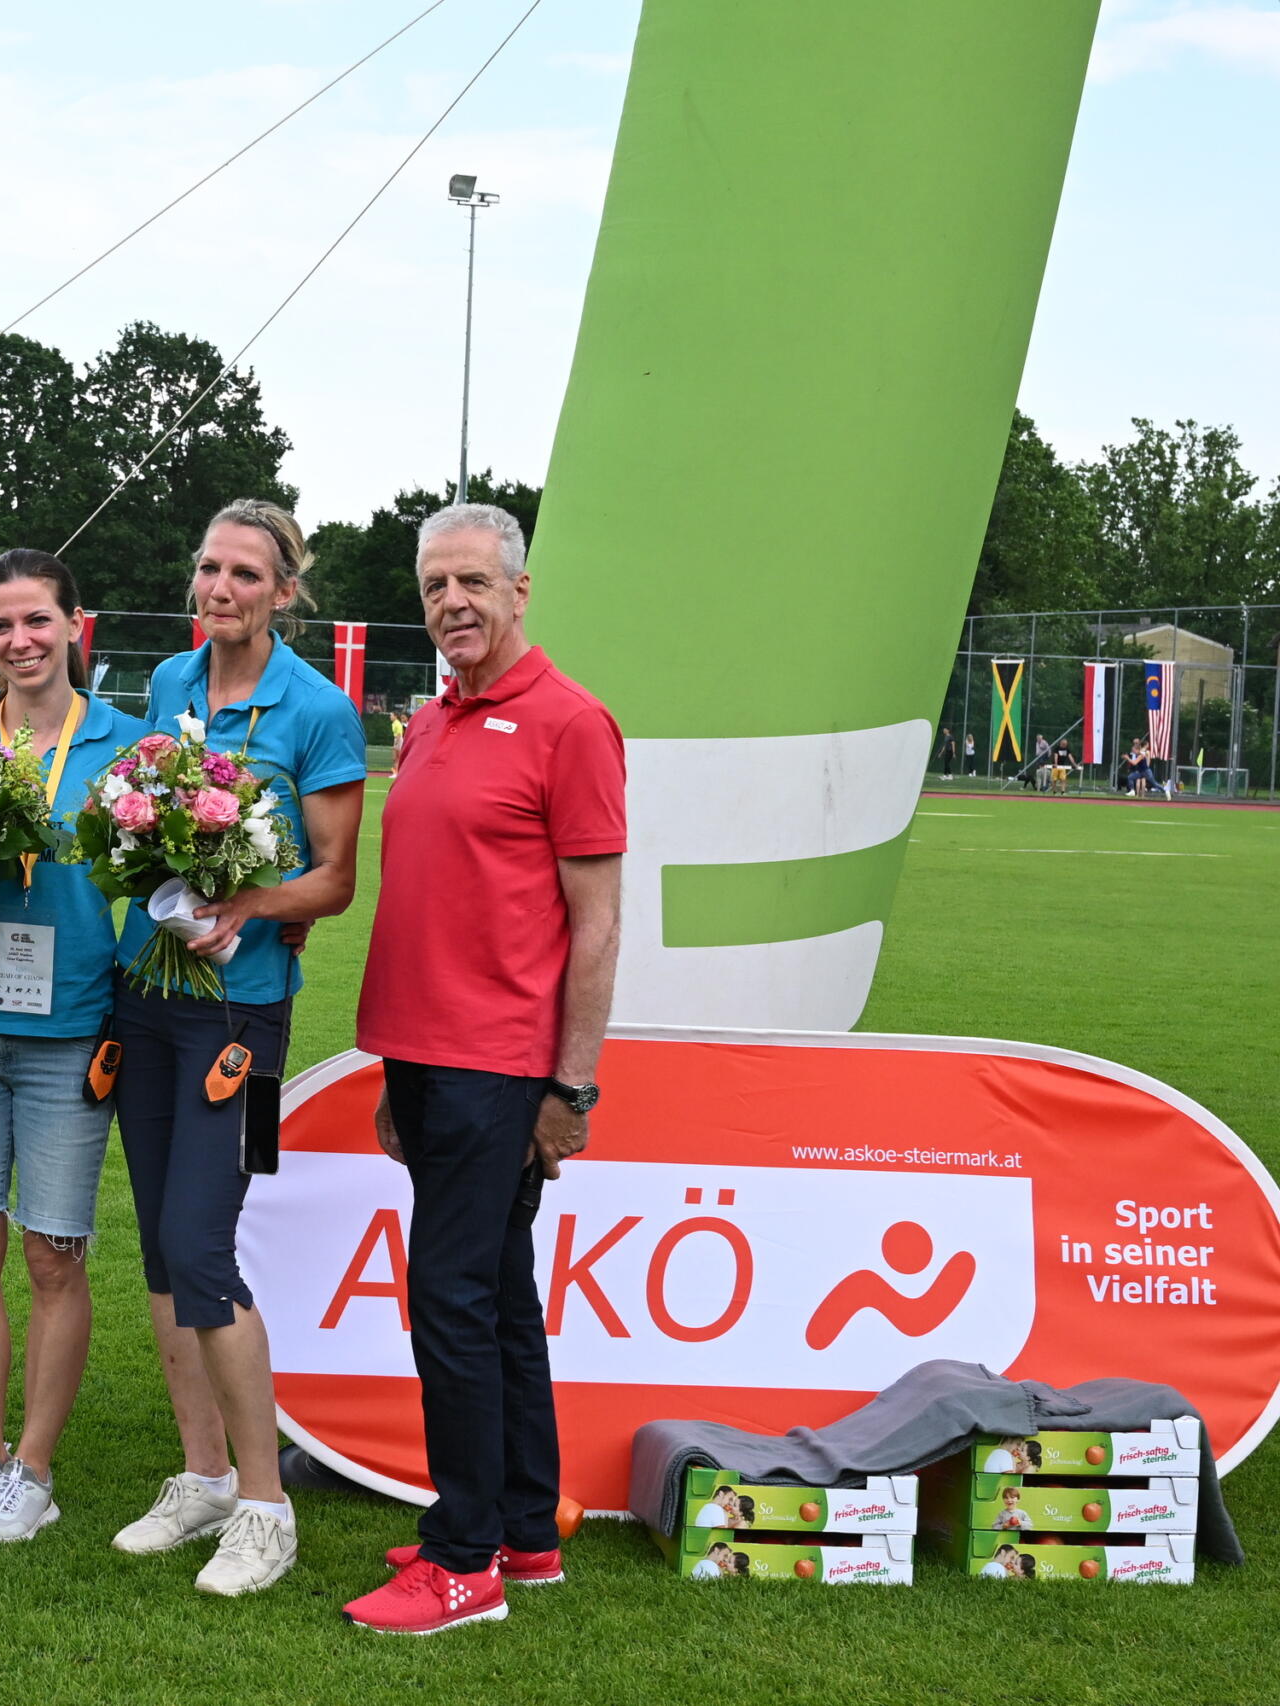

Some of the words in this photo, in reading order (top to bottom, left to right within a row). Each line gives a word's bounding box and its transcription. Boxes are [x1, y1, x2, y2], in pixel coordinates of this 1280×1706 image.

[791, 1144, 1022, 1169] www.askoe-steiermark.at
[1115, 1199, 1213, 1235] Sport
[1060, 1234, 1093, 1263] in
[1104, 1238, 1215, 1267] seiner
[318, 1187, 755, 1344] AKÖ
[1086, 1274, 1217, 1305] Vielfalt
[1119, 1446, 1169, 1464] frisch-saftig
[1142, 1453, 1177, 1465] steirisch
[834, 1503, 886, 1521] frisch-saftig
[858, 1510, 894, 1522] steirisch
[1117, 1504, 1167, 1522] frisch-saftig
[1140, 1510, 1175, 1522] steirisch
[829, 1560, 880, 1578] frisch-saftig
[1113, 1560, 1163, 1577] frisch-saftig
